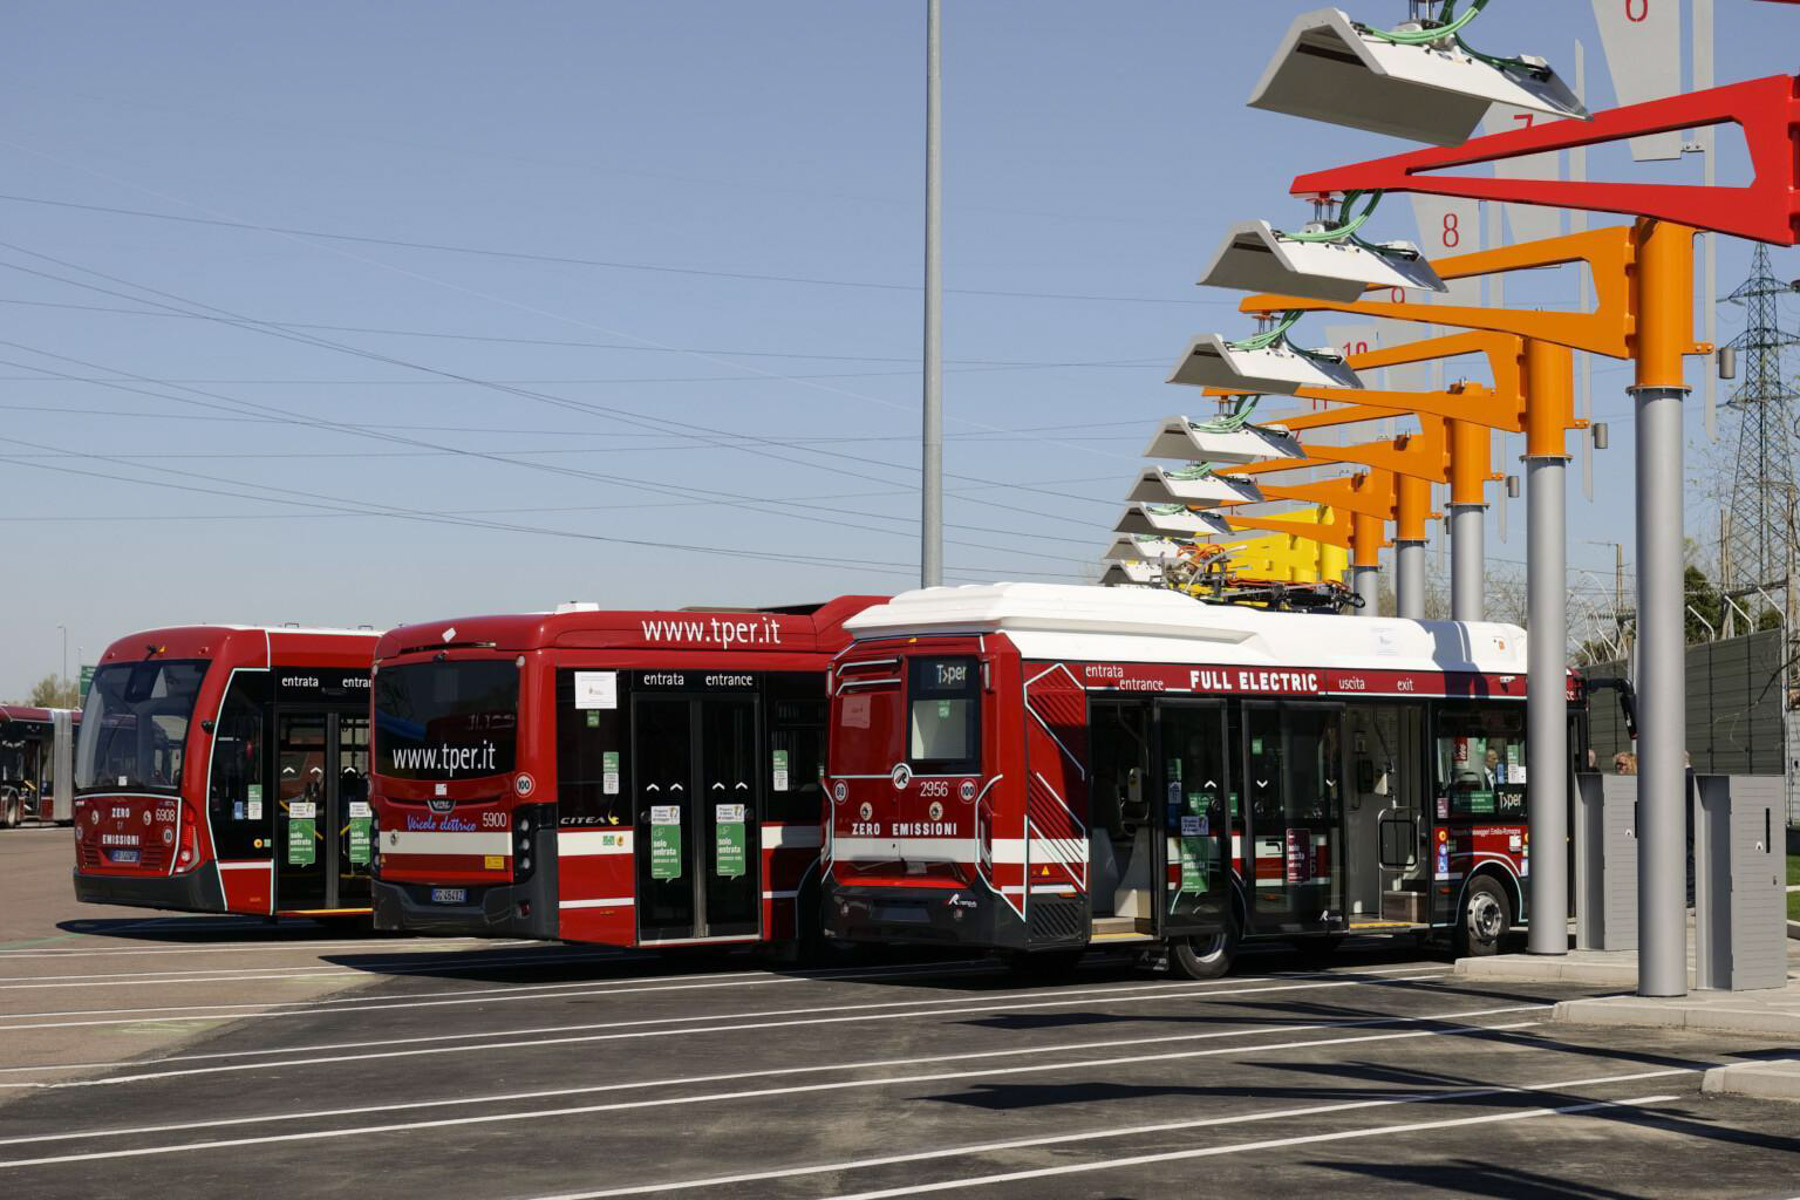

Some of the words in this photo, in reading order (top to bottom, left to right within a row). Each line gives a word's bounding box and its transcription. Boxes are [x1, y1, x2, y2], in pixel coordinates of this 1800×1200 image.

[1442, 213, 1460, 247] 8
[641, 617, 781, 650] www.tper.it
[1086, 665, 1123, 678] entrata
[282, 676, 319, 688] entrata
[643, 672, 685, 686] entrata
[705, 673, 753, 686] entrance
[1119, 679, 1164, 691] entrance
[1189, 670, 1232, 690] FULL
[1239, 671, 1318, 692] ELECTRIC
[1338, 676, 1366, 690] uscita
[1397, 677, 1414, 691] exit
[393, 739, 496, 778] www.tper.it
[518, 779, 531, 790] 100
[920, 781, 948, 797] 2956
[962, 785, 975, 796] 100
[836, 786, 845, 797] 80
[112, 807, 130, 818] ZERO
[155, 808, 176, 822] 6908
[407, 814, 437, 831] Veicolo
[440, 815, 477, 831] elettrico
[482, 812, 507, 827] 5900
[852, 823, 881, 835] ZERO
[892, 823, 957, 836] EMISSIONI
[102, 834, 139, 845] EMISSIONI
[653, 846, 677, 857] entrata
[717, 845, 742, 855] entrata
